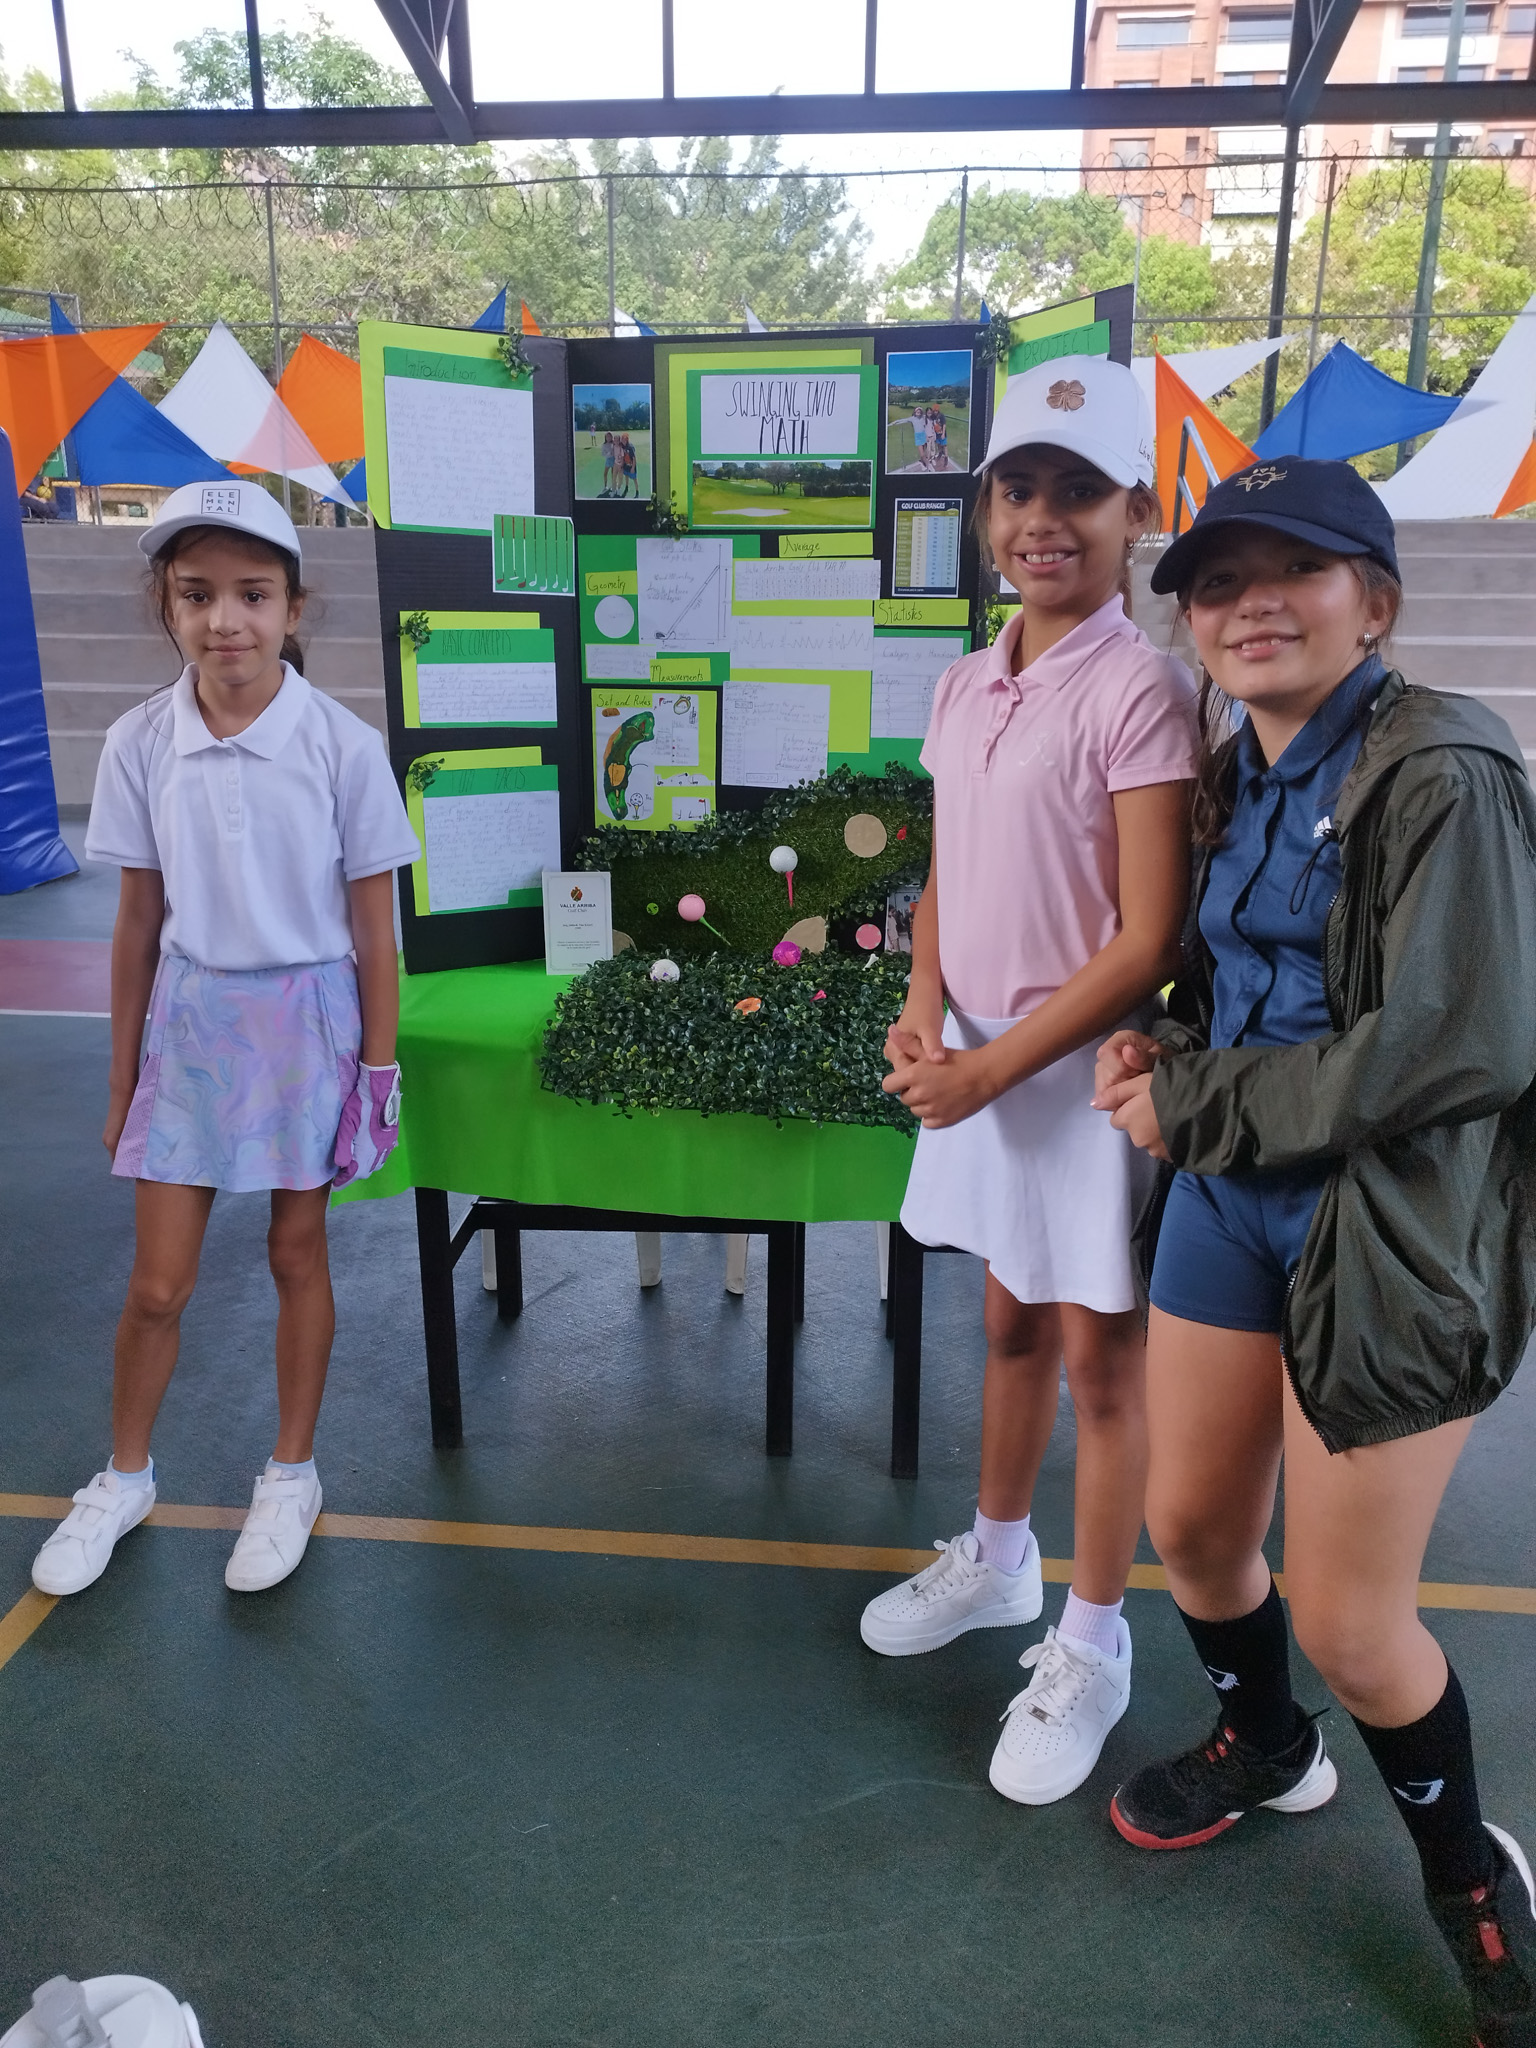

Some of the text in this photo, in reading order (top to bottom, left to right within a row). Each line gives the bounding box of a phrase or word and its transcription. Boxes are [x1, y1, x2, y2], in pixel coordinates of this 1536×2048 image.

[1023, 327, 1094, 367] PROJECT
[404, 349, 478, 380] Introduction
[725, 380, 837, 421] SWINGING INTO
[759, 416, 810, 454] MATH
[206, 498, 235, 506] MEN
[207, 491, 235, 499] ELE
[206, 505, 234, 513] TAL
[926, 502, 946, 510] RANGES
[783, 535, 820, 558] Average
[586, 574, 627, 595] Geometry
[442, 629, 512, 657] BASIC CONCEPTS
[650, 664, 704, 682] Measurements
[596, 693, 614, 707] Set
[616, 695, 631, 706] and
